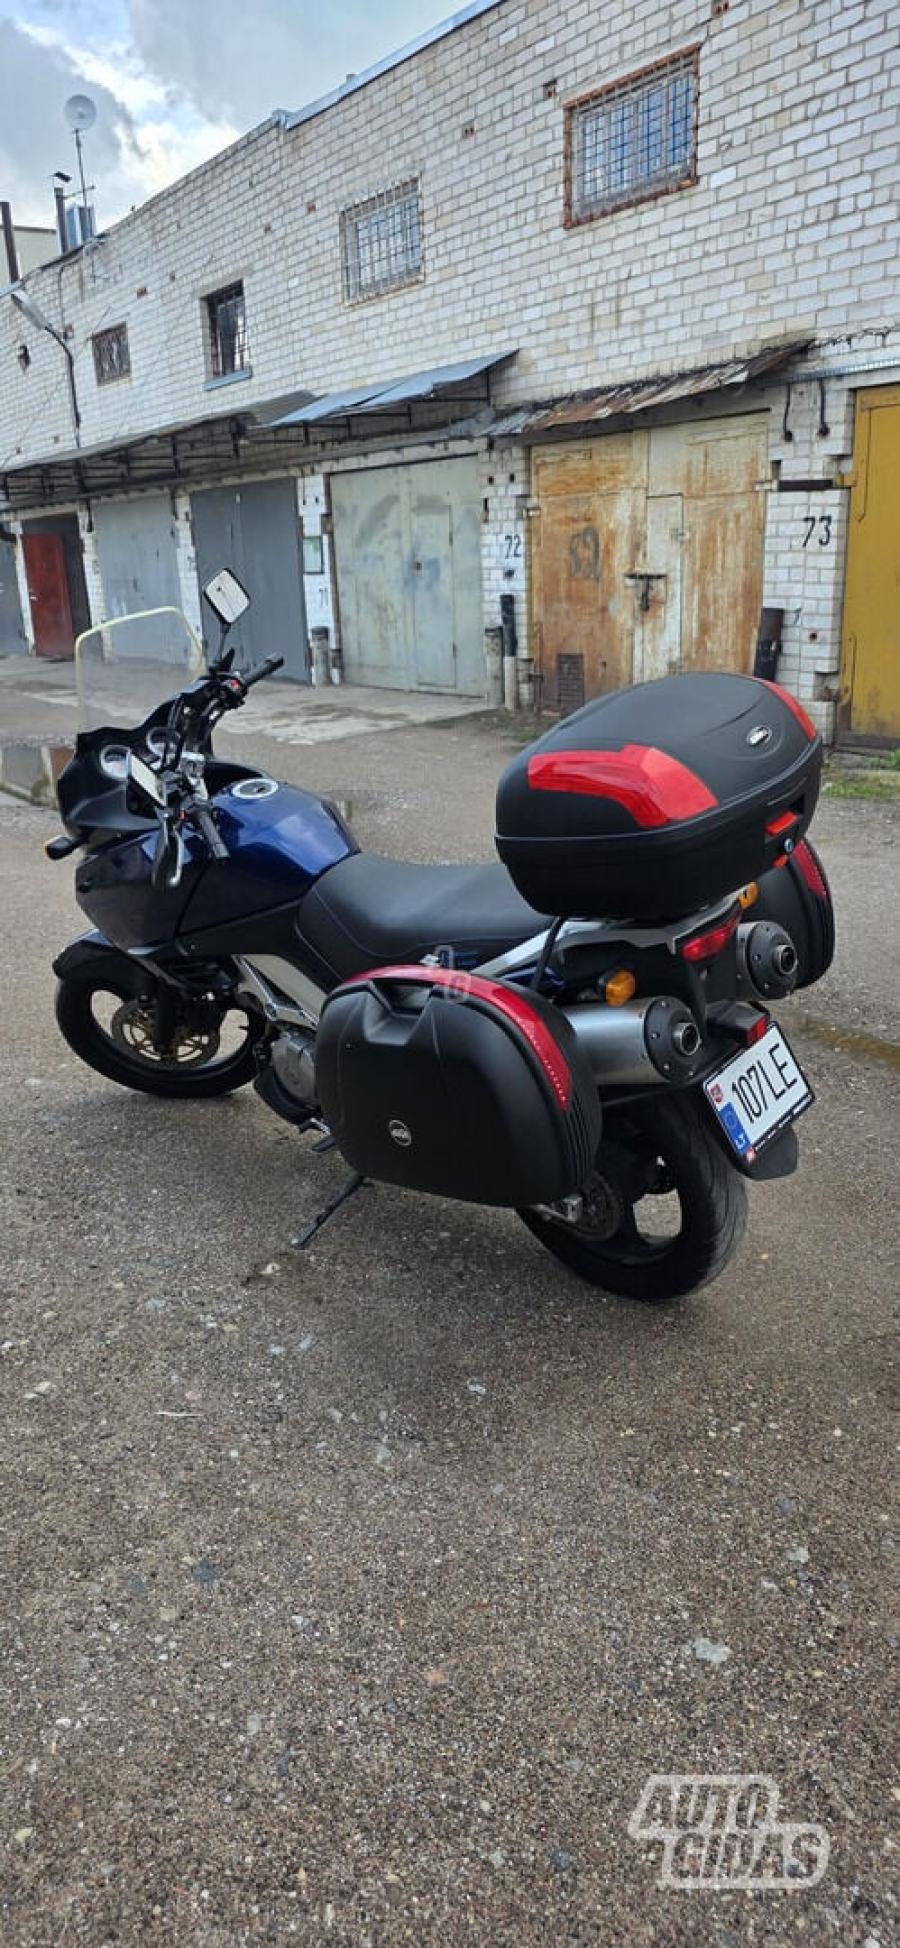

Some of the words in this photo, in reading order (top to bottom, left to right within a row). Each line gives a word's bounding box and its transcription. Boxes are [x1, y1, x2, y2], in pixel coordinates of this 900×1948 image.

[504, 534, 521, 560] 72
[802, 514, 832, 548] 73
[731, 1043, 798, 1124] 107LE
